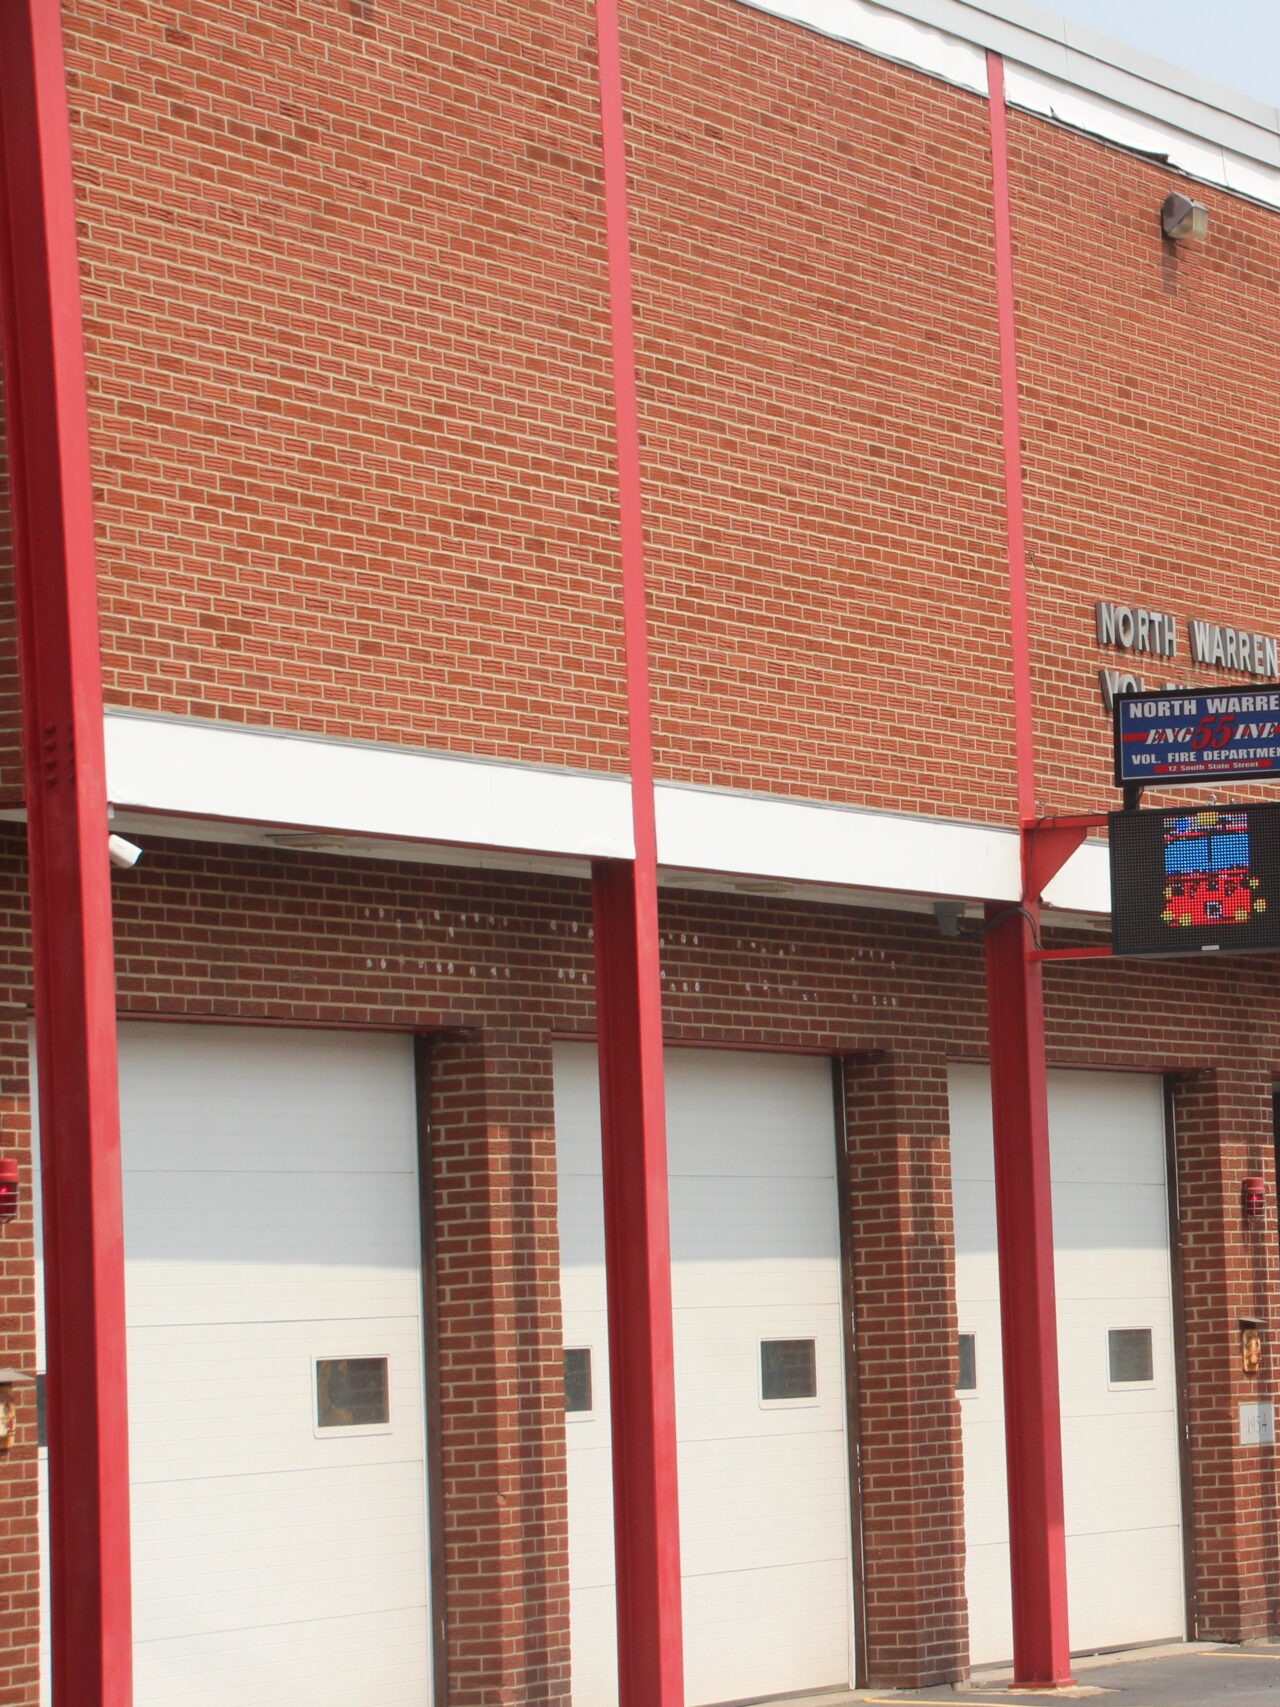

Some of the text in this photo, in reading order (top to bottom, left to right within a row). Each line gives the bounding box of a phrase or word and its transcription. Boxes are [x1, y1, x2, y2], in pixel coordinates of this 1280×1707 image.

[1096, 601, 1279, 677] NORTH WARREN
[1129, 699, 1197, 718] NORTH
[1131, 753, 1161, 765] VOL.
[1167, 751, 1197, 763] FIRE
[1180, 764, 1205, 772] South
[1208, 762, 1229, 770] State
[1233, 761, 1259, 769] Street
